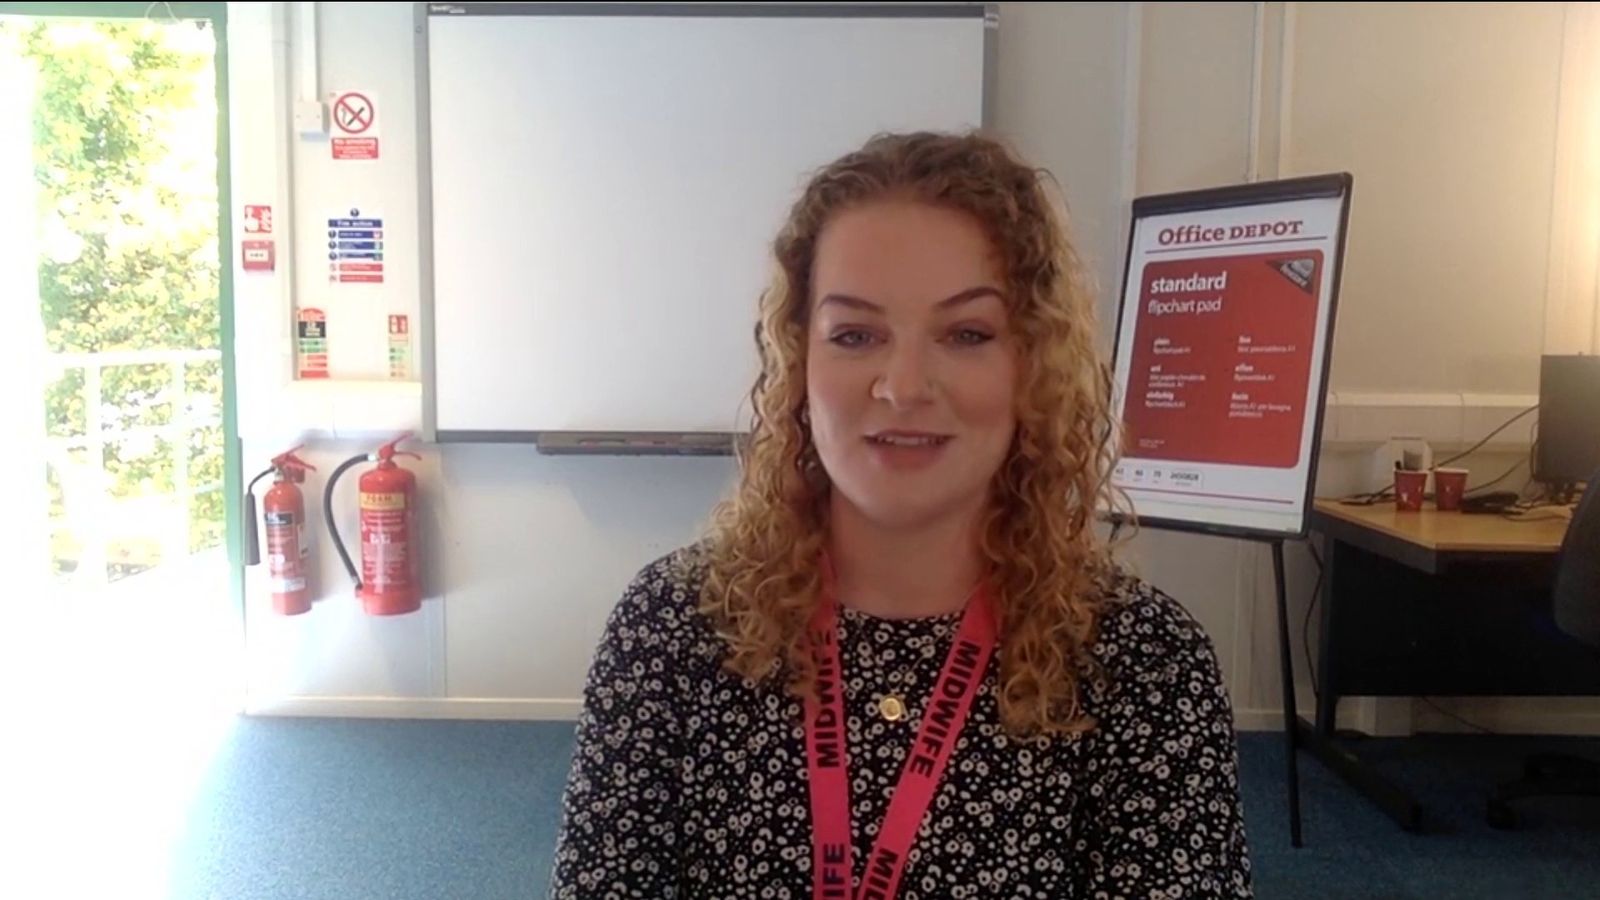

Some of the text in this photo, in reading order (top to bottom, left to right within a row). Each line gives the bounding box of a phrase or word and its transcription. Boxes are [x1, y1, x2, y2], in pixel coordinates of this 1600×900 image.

[1157, 220, 1303, 246] Office DEPOT
[1150, 269, 1227, 294] standard
[1148, 296, 1222, 316] flipchart pad
[813, 630, 841, 768] MIDWI
[909, 640, 982, 778] MIDWIFE
